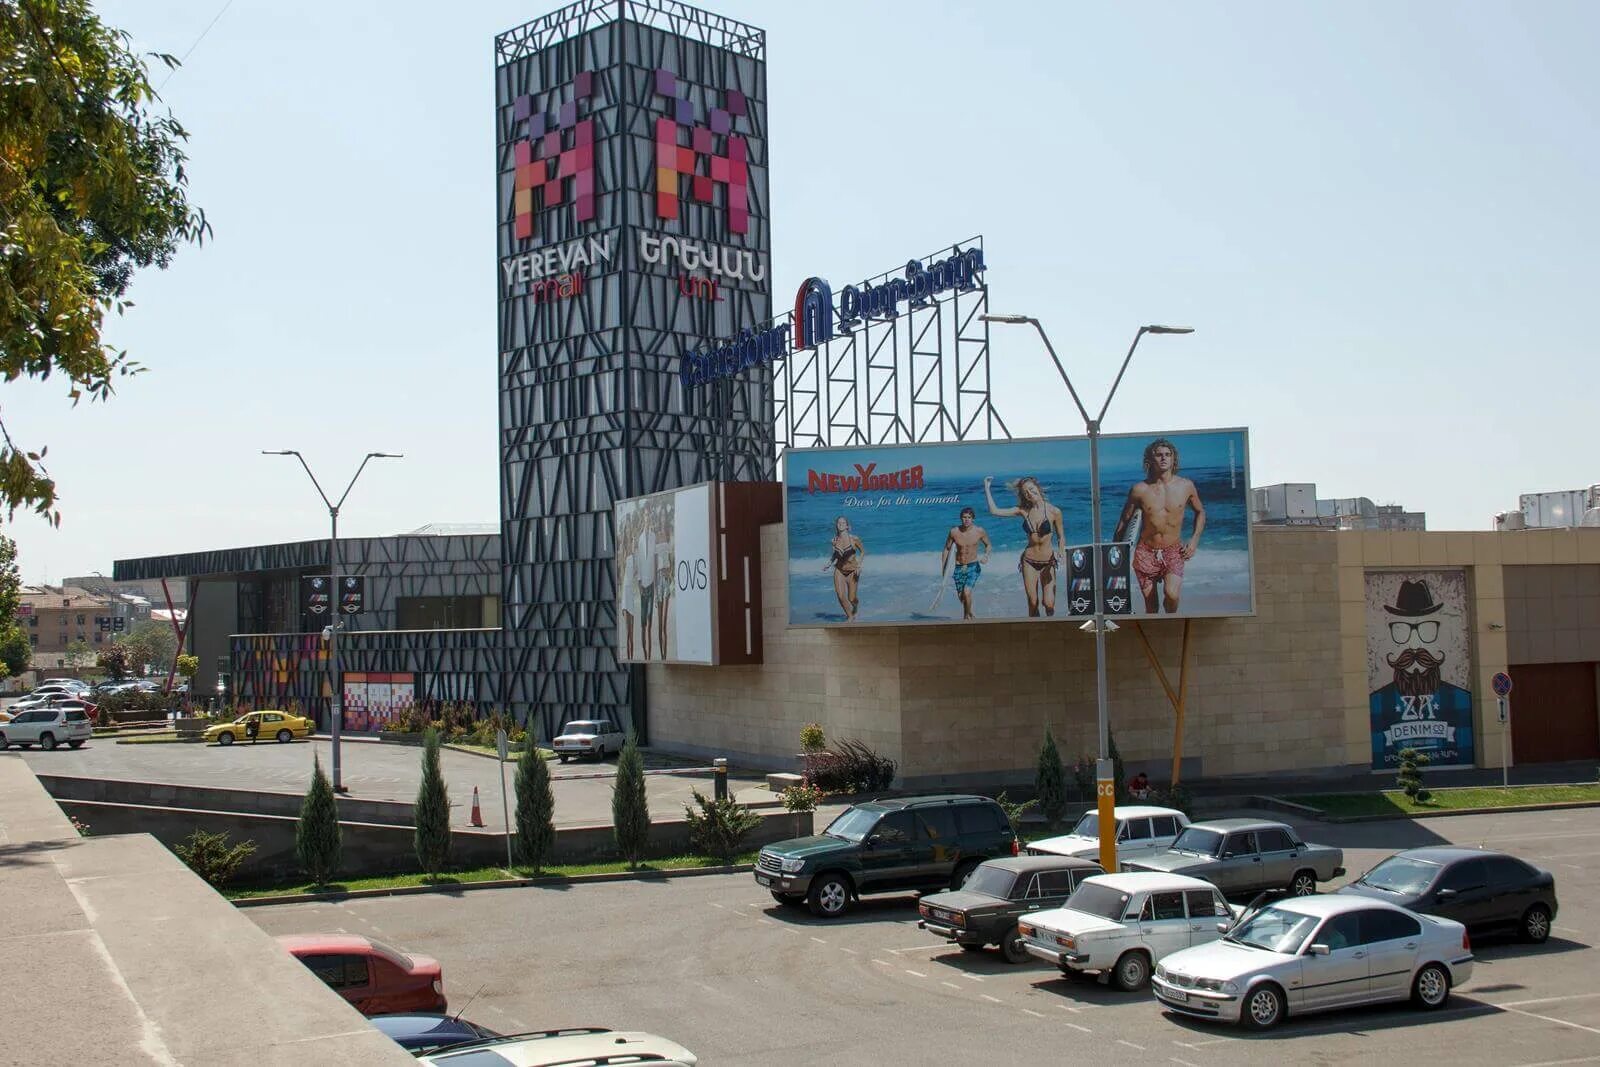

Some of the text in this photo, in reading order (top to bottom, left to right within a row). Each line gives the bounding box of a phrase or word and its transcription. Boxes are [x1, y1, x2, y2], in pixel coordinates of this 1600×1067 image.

[502, 234, 611, 286] YEREVAN
[640, 231, 765, 282] ԵՐԵՎԱՆ
[531, 272, 585, 304] mall
[680, 322, 792, 386] Carrefour
[845, 495, 874, 508] Dress
[876, 496, 892, 509] for
[895, 495, 912, 506] the
[677, 558, 708, 592] OVS
[1393, 724, 1432, 738] DENIM
